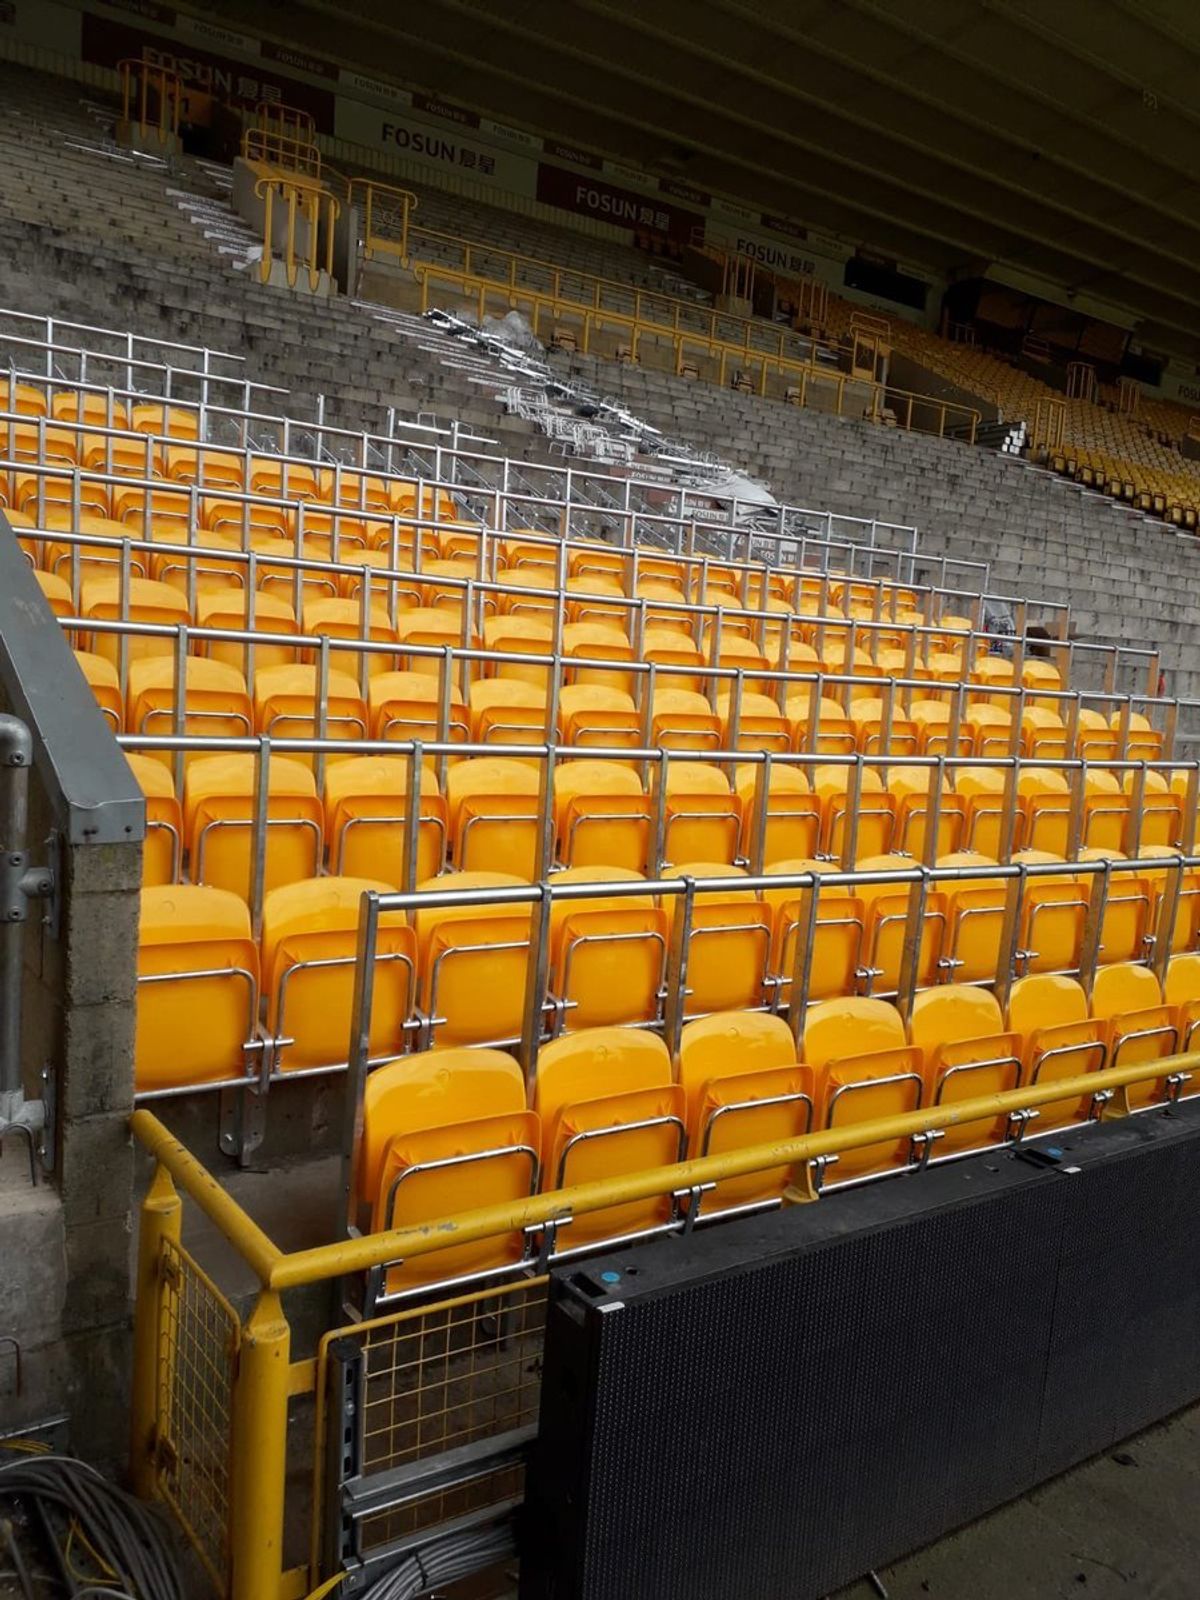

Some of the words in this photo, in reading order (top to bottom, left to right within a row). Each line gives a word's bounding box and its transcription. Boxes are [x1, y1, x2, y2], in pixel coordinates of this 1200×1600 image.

[382, 123, 455, 162] FOSUN
[576, 186, 637, 220] FOSUN
[737, 239, 787, 267] FOSUN
[1178, 384, 1200, 402] FOSU
